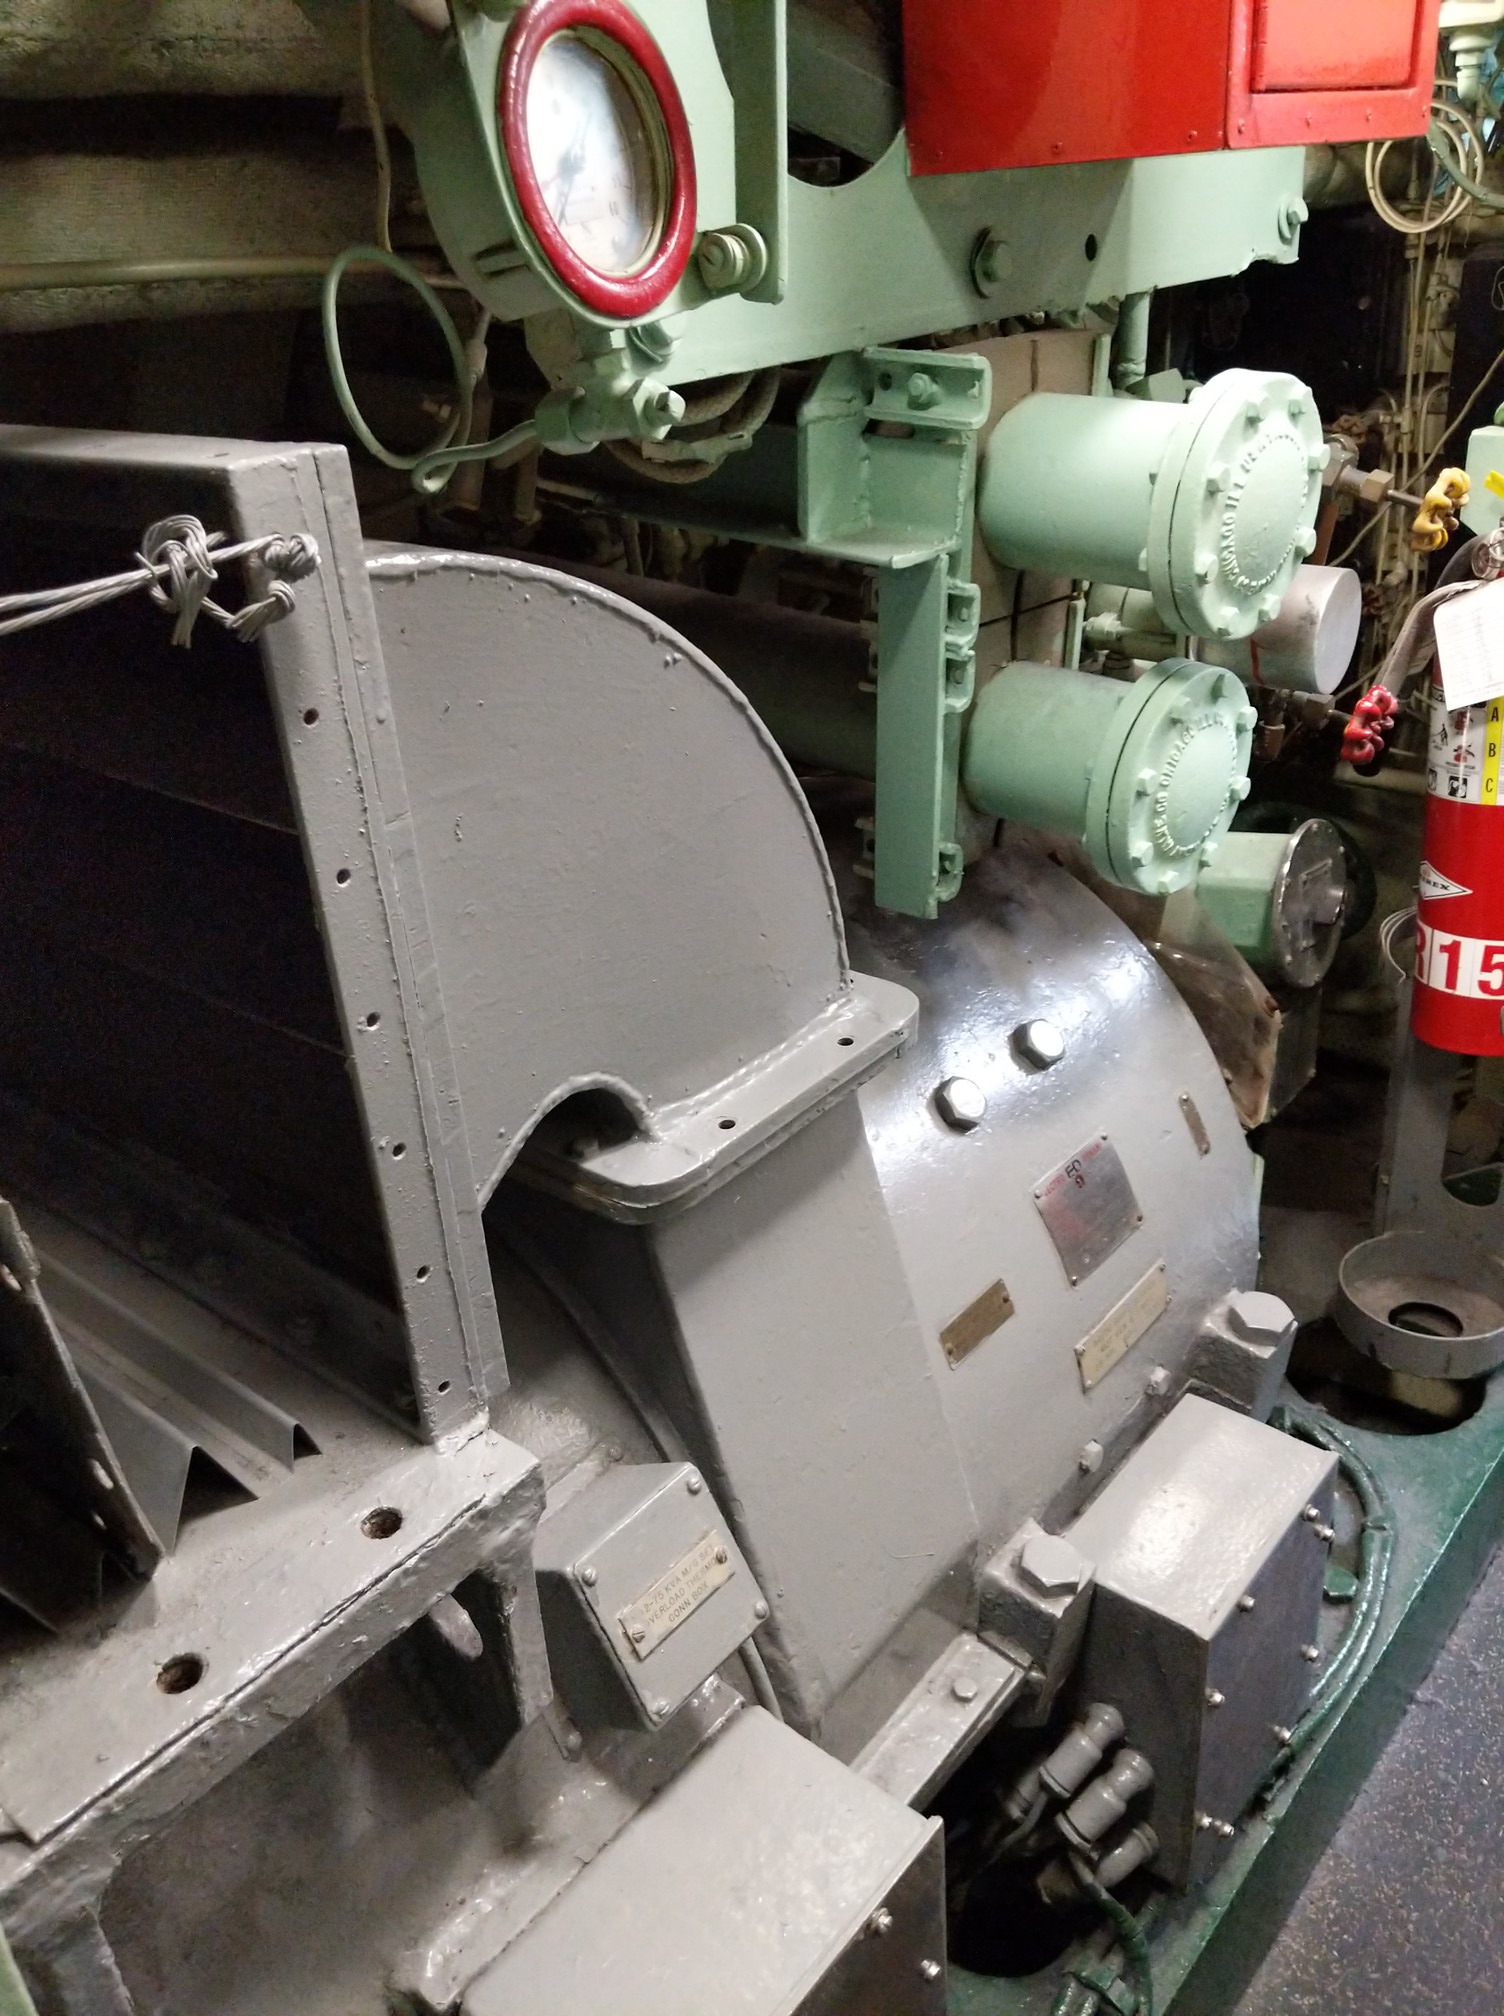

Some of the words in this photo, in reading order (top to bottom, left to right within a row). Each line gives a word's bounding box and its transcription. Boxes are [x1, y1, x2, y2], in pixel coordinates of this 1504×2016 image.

[1491, 707, 1499, 722] A
[1488, 742, 1496, 758] B
[1485, 778, 1493, 793] C
